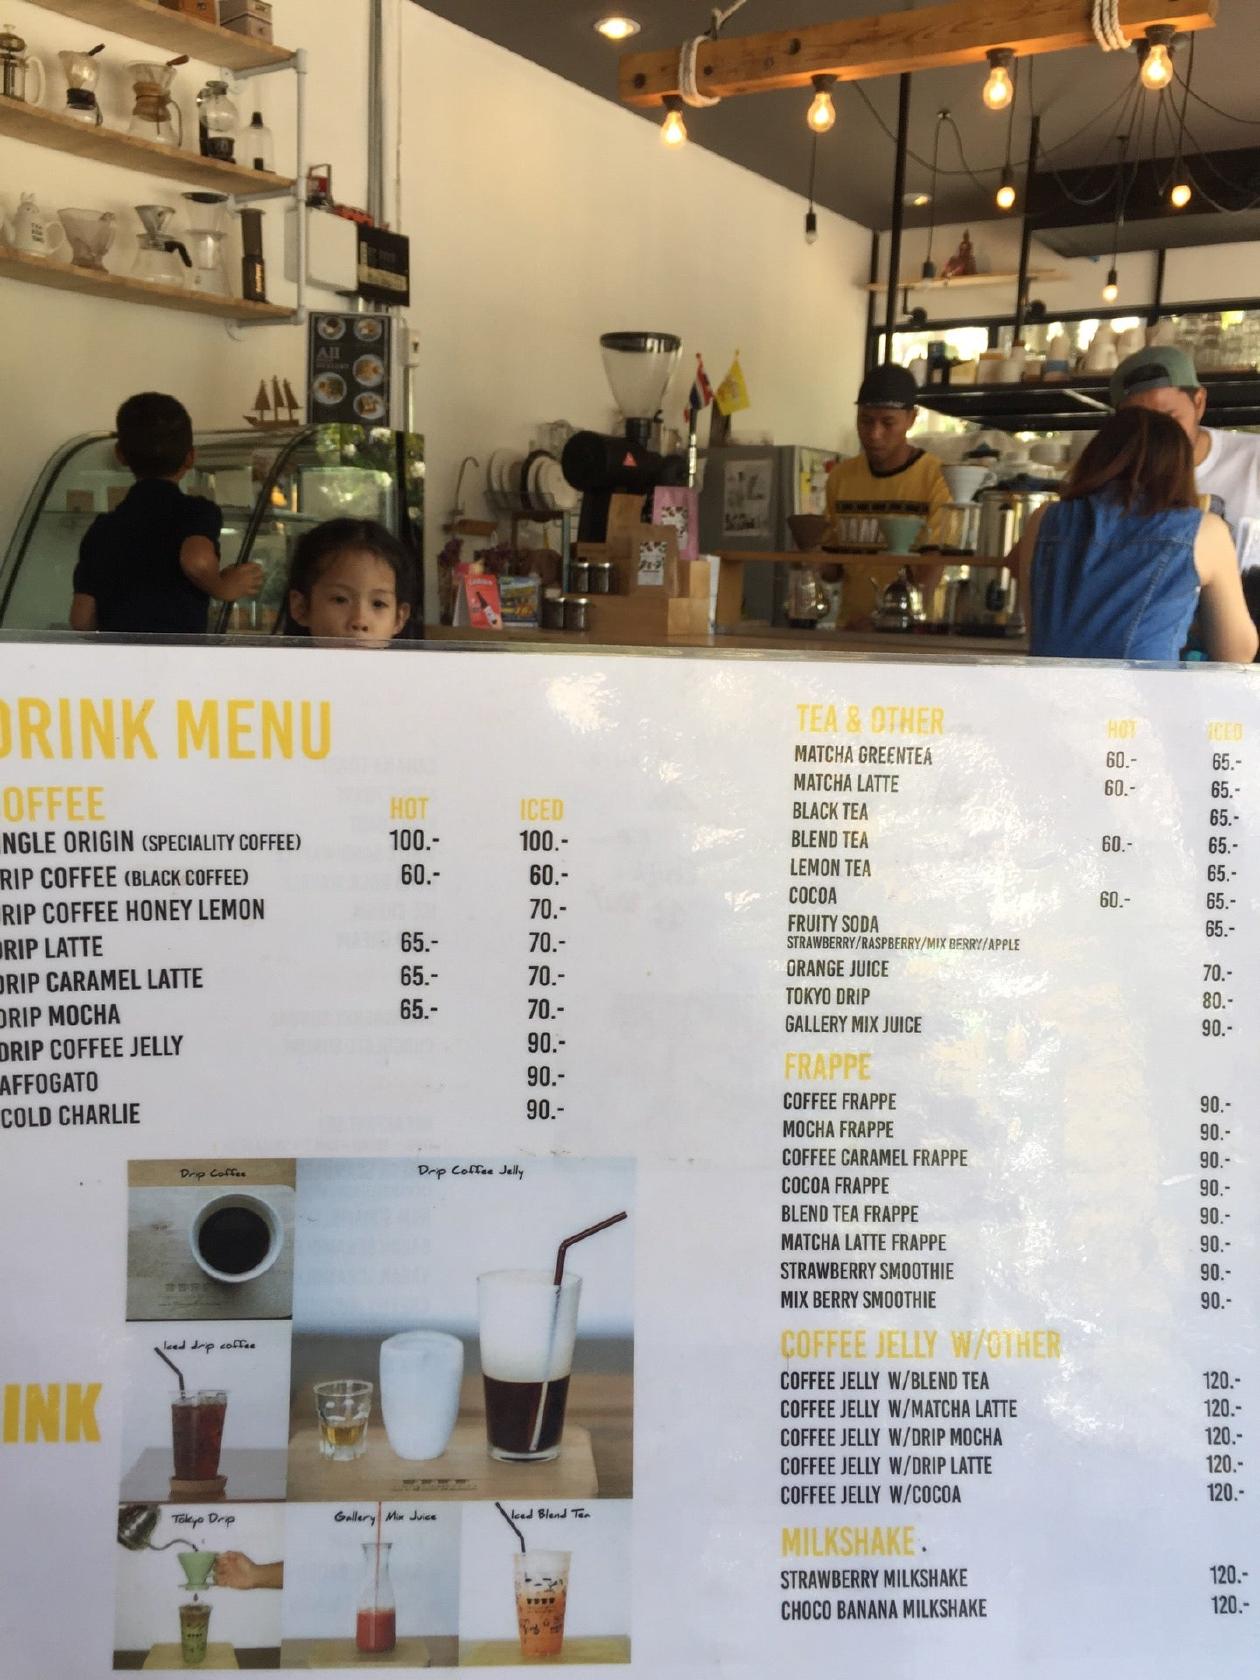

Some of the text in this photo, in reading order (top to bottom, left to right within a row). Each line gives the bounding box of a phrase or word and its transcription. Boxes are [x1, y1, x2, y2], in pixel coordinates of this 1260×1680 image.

[177, 700, 330, 760] MENU
[797, 704, 944, 735] TEA & OTHER
[795, 745, 1241, 770] MATCHA GREENTEA 60.- 65.-
[794, 773, 1240, 798] MATCHA LATTE 60.- 65.-
[390, 796, 564, 821] HOT ICED
[793, 802, 1239, 826] BLACK TEA 65.-
[64, 829, 568, 853] ORIGIN (SPECIALITY COFFEE) 100.- 100.-
[792, 830, 1238, 854] BLEND TEA 60.- 65.-
[41, 864, 568, 889] COFFEE (BLACK COFFEE) 60.- 60.-
[791, 858, 1236, 882] LEMON TEA 65.-
[789, 886, 1236, 909] COCOA 60.- 65.-
[43, 899, 566, 924] COFFEE HONEY LEMON 70.-
[788, 915, 1235, 937] FRUITY SODA 65.-
[45, 932, 565, 958] LATTE 65.- 70.-
[47, 965, 565, 992] CARAMEL LATTE 65.- 70.-
[787, 959, 1232, 981] ORANGE JUICE 70.-
[786, 987, 1233, 1009] TOKYO DRIP 80.-
[49, 999, 564, 1026] MOCHA 65.- 70.-
[786, 1015, 1232, 1036] GALLERY MIX JUICE 90.-
[51, 1032, 565, 1060] COFFEE JELLY 90.-
[785, 1053, 871, 1080] FRAPPE
[0, 1071, 98, 1095] AFFOGATO
[784, 1092, 1231, 1113] COFFEE FRAPPE 90.-
[1, 1103, 140, 1128] COLD CHARLIE
[783, 1120, 893, 1138] MOCHA FRAPPE
[783, 1148, 1230, 1168] COFFEE CARAMEL FRAPPE 90.-
[180, 1168, 246, 1181] Drip Coffee
[418, 1165, 523, 1180] Drip Coffee Jelly
[782, 1176, 889, 1194] COCOA FRAPPE
[782, 1205, 1230, 1224] BLEND TEA FRAPPE 90.-
[782, 1234, 946, 1251] MATCHA LATTE FRAPPE
[781, 1262, 1231, 1281] STRAWBERRY SMOOTHIE 90.-
[781, 1291, 936, 1308] MIX BERRY SMOOTHIE
[163, 1340, 255, 1354] Iced drip coffee
[781, 1329, 1060, 1360] COFFEE JELLY W/OTHER
[781, 1370, 1240, 1390] COFFEE JELLY W/BLEND TEA 120.-
[781, 1399, 1241, 1418] COFFEE JELLY W/MATCHA LATTE 120.-
[781, 1427, 1242, 1447] COFFEE JELLY W/DRIP MOCHA 120.-
[781, 1454, 1243, 1476] COFFEE JELLY W/DRIP LATTE 120.-
[781, 1483, 1244, 1505] COFFEE JELLY W/COCOA 120.-
[208, 1512, 235, 1528] Drip
[334, 1510, 437, 1526] Gallery Mix Juice
[511, 1508, 590, 1520] Iced Blend Tea
[782, 1526, 914, 1556] MILKSHAKE
[781, 1565, 1248, 1589] STRAWBERRY MILKSHAKE 120.-
[782, 1595, 1249, 1620] CHOCO BANANA MILKSHAKE 120.-
